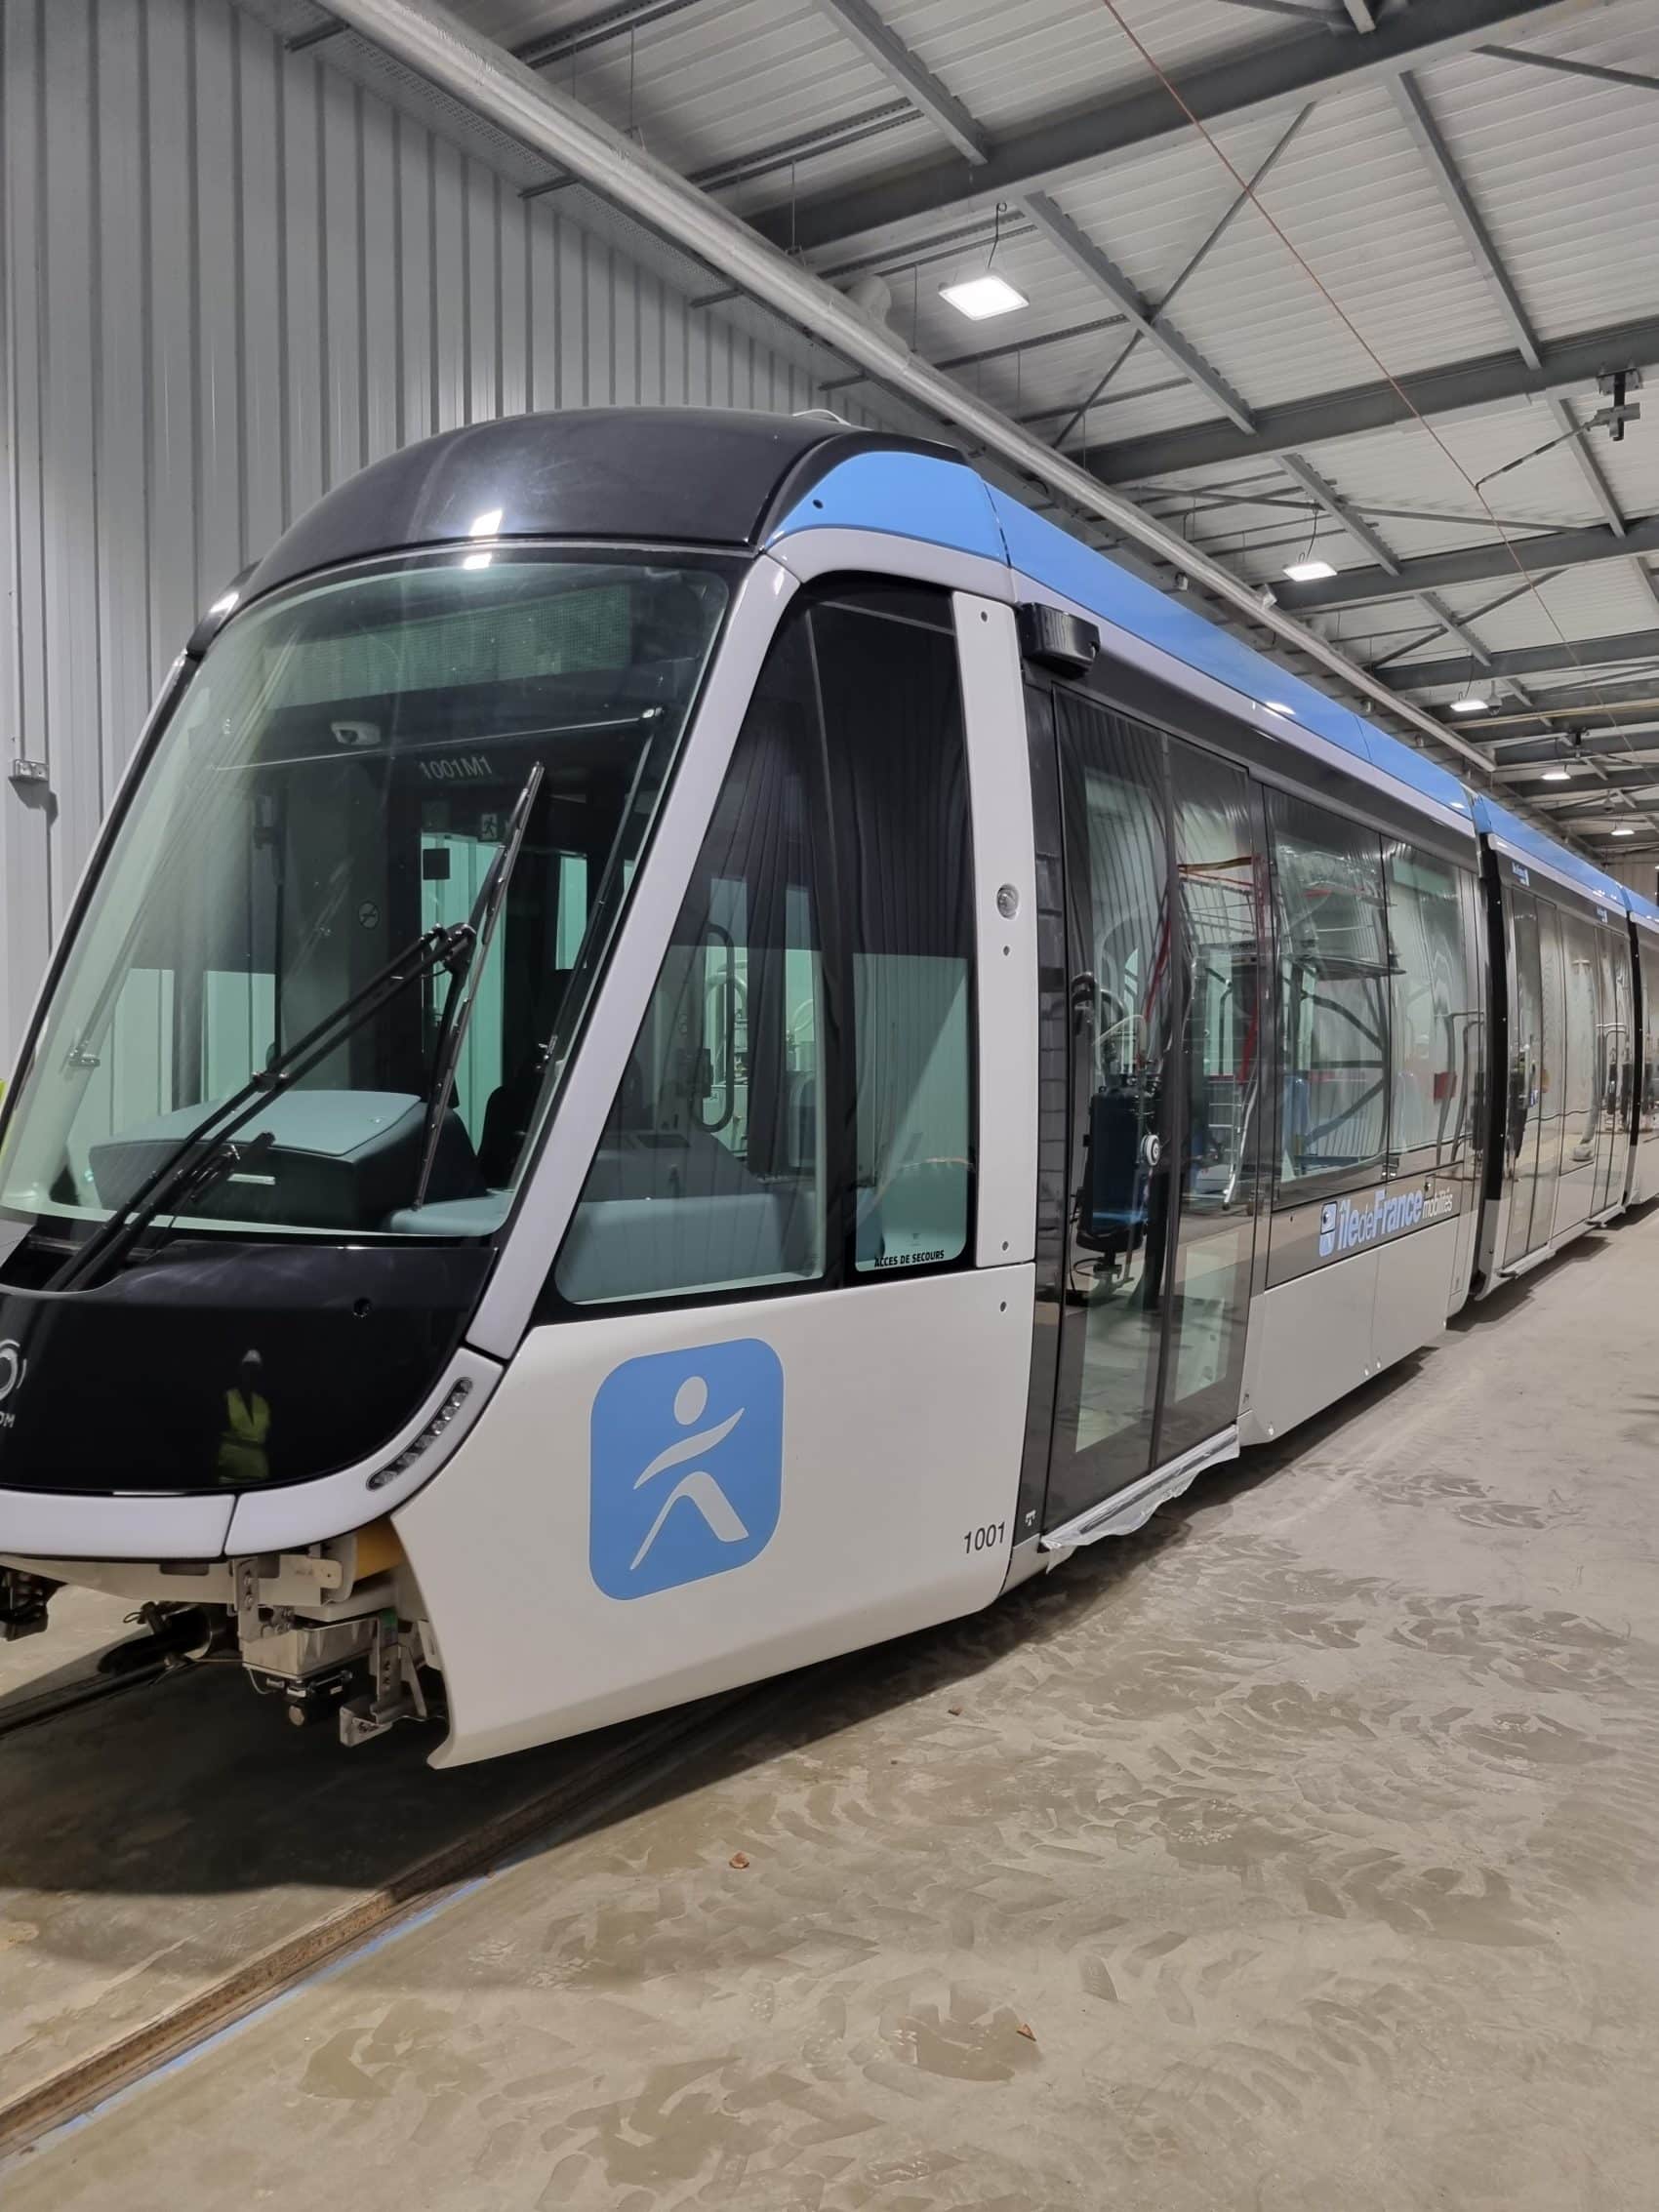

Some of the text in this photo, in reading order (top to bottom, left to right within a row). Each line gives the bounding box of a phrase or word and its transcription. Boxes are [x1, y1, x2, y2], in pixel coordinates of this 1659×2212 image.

[420, 756, 492, 780] 1001M1
[873, 1250, 945, 1267] ACCES DE SECOURS
[964, 1521, 1005, 1553] 1001
